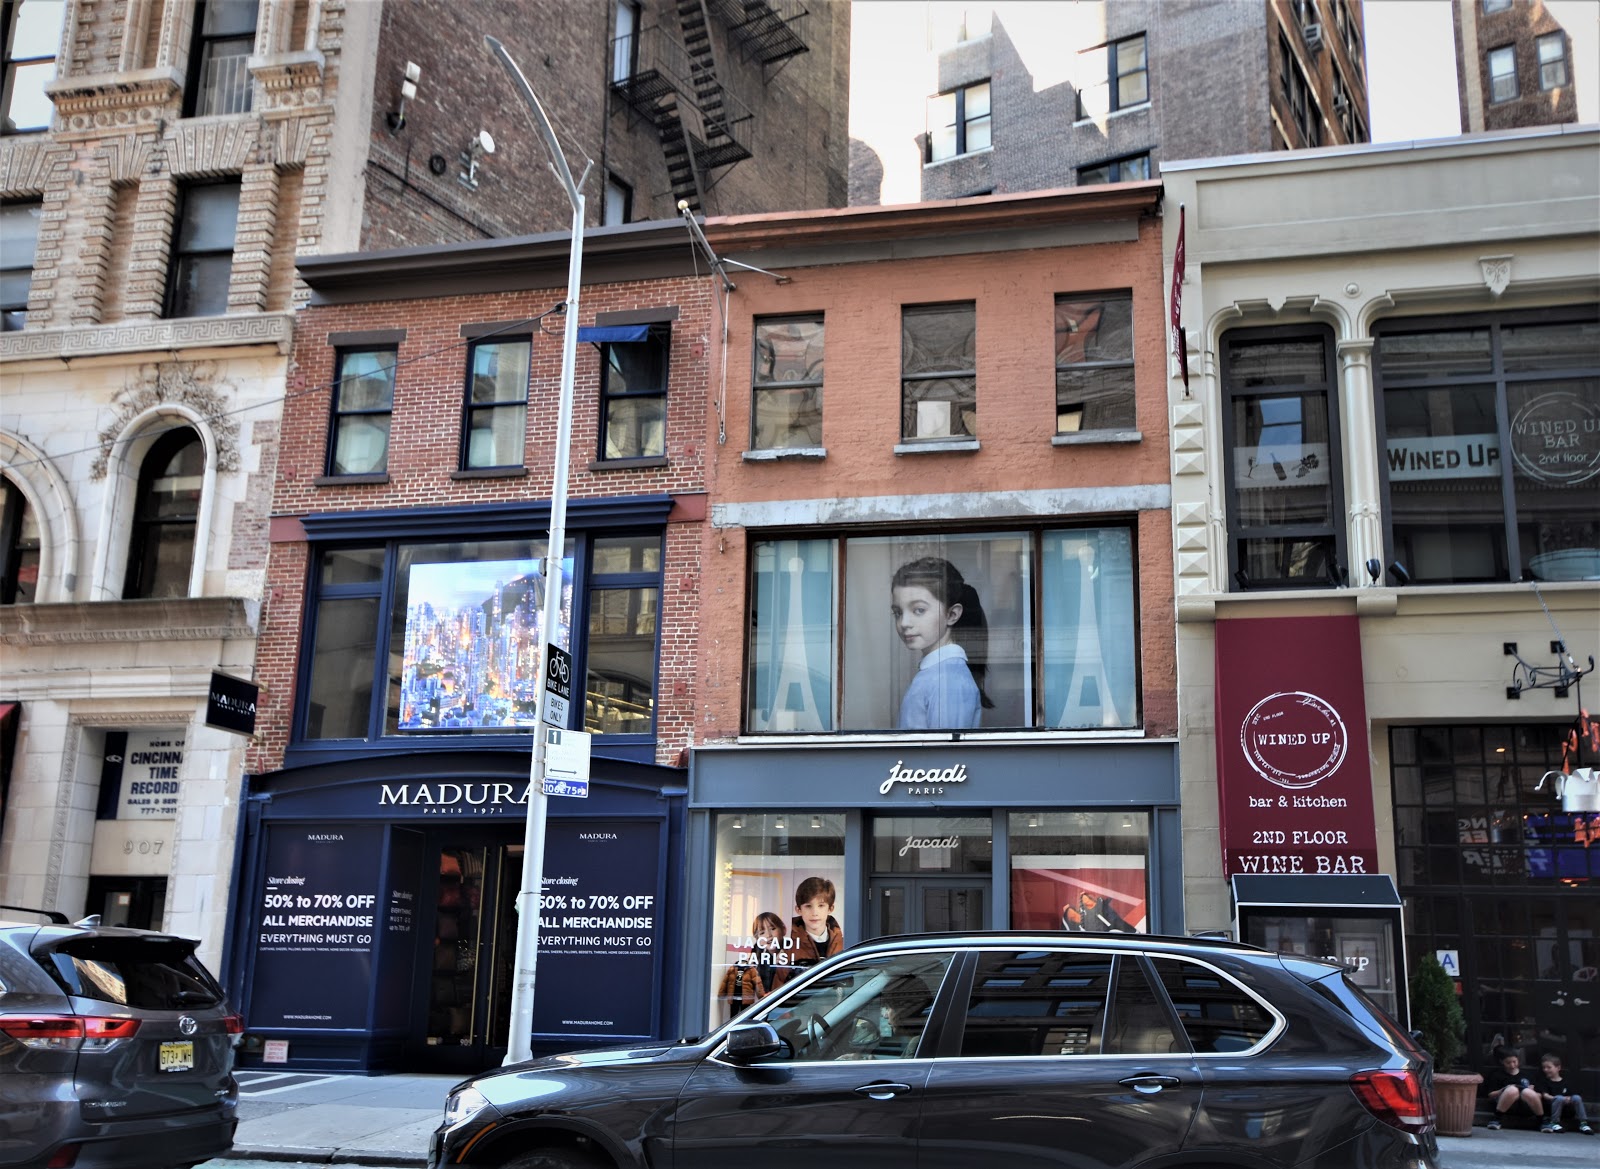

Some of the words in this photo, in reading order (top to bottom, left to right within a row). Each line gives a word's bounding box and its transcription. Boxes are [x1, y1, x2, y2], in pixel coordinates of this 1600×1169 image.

[1514, 419, 1577, 436] WINED
[1543, 433, 1580, 448] BAR
[1538, 453, 1560, 465] 2nd
[547, 678, 558, 691] BIKE
[557, 683, 570, 697] LANE
[211, 691, 256, 713] MADURA
[550, 698, 564, 711] BIKES
[550, 710, 563, 722] ONLY
[1257, 733, 1307, 746] WINED
[1311, 733, 1331, 745] UP
[149, 766, 178, 780] TIME
[879, 759, 967, 795] jacadi
[130, 781, 180, 795] RECORD
[908, 787, 944, 795] PARIS
[1248, 796, 1273, 808] bar
[1278, 796, 1288, 808] &
[1293, 796, 1347, 808] kitchen
[473, 807, 503, 815] 1971
[1252, 831, 1286, 844] 2ND
[1292, 831, 1348, 844] FLOOR
[122, 839, 164, 855] 907
[1238, 855, 1304, 874] WINE
[1315, 855, 1366, 874] BAR
[267, 876, 284, 885] Store
[284, 876, 306, 886] closing
[556, 876, 579, 886] closing
[264, 894, 294, 908] 50%
[296, 895, 311, 908] to
[313, 894, 343, 908] 70%
[346, 894, 376, 909] OFF
[570, 896, 586, 910] to
[589, 895, 620, 910] 70%
[622, 895, 654, 910] OFF
[262, 915, 286, 927] ALL
[288, 915, 374, 927] MERCHANDISE
[538, 917, 560, 928] ALL
[562, 917, 653, 929] MERCHANDISE
[260, 933, 324, 944] EVERYTHING
[325, 934, 354, 944] MUST
[356, 934, 372, 944] GO
[603, 936, 633, 946] MUST
[636, 936, 652, 946] GO
[733, 936, 800, 950] JACADI
[738, 952, 795, 966] PARIS!
[1441, 953, 1455, 968] A
